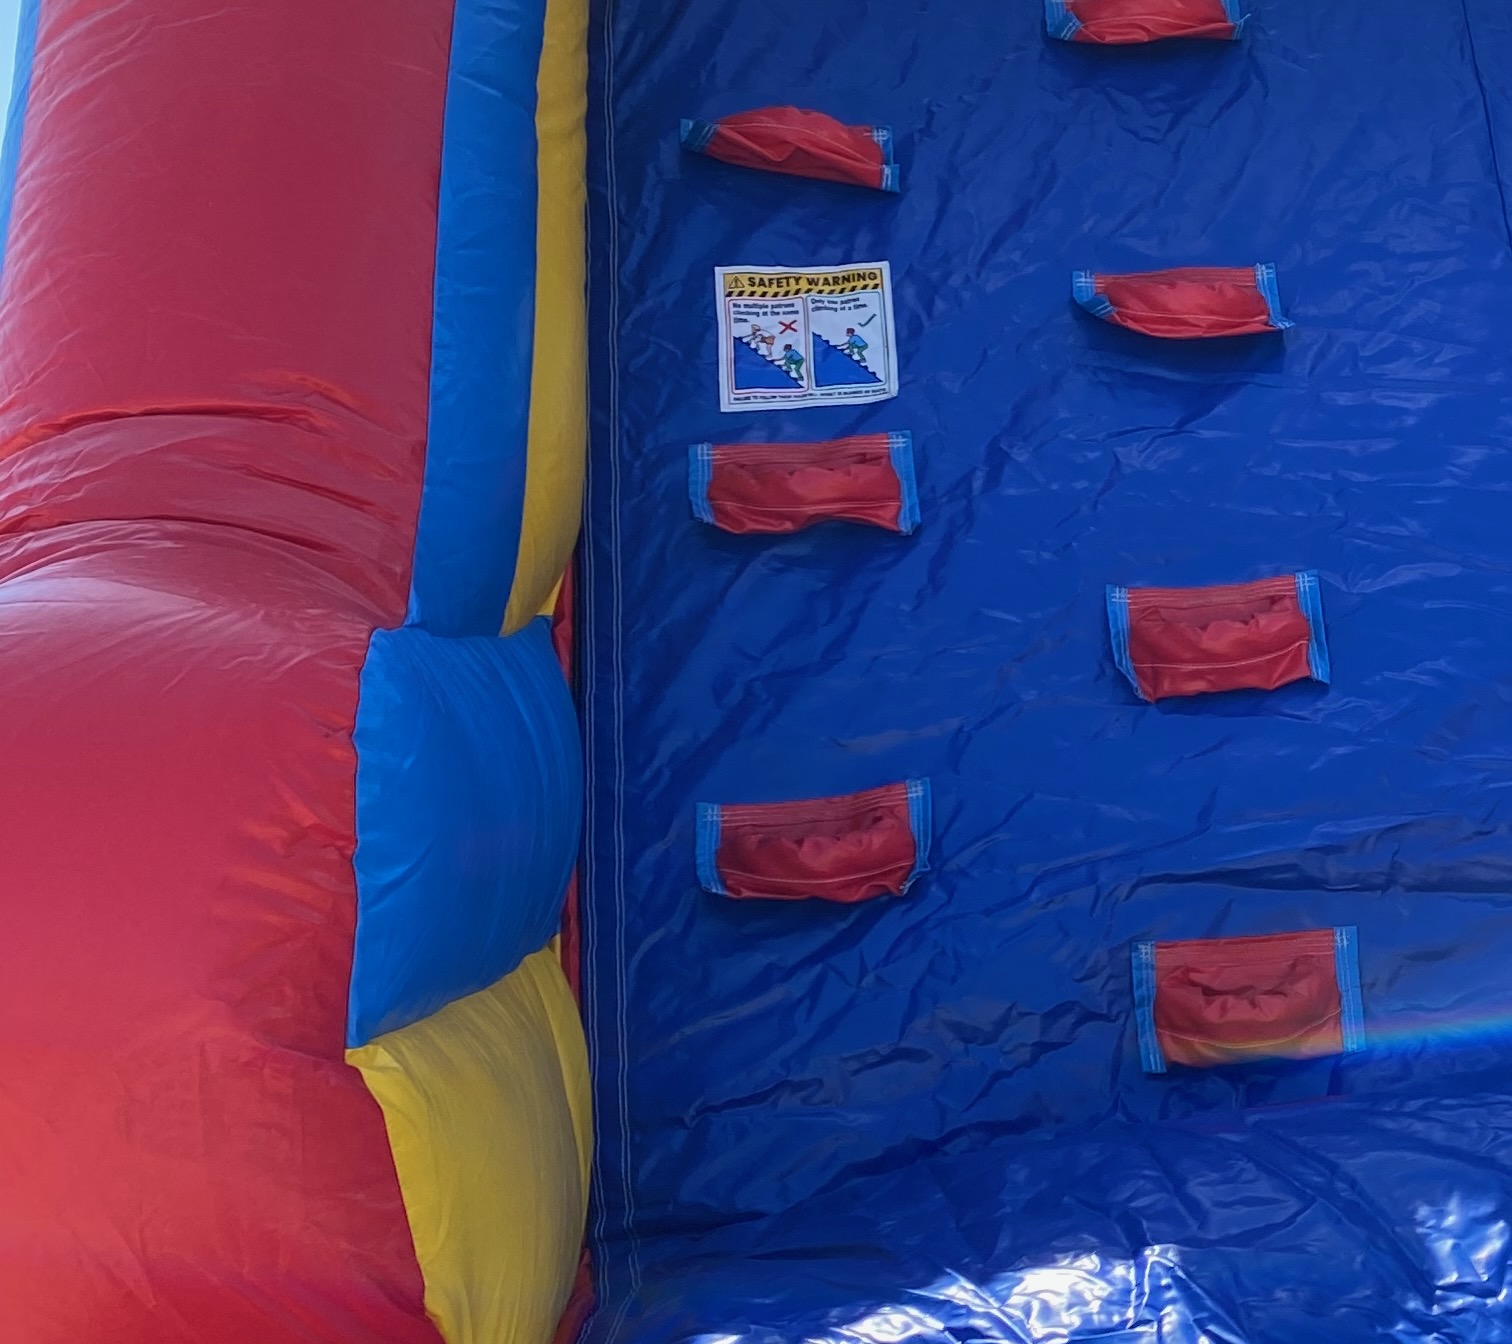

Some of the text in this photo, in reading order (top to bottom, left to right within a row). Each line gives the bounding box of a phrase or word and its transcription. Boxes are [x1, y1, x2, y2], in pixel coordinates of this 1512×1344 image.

[747, 271, 878, 289] SAFETY WARNING
[811, 305, 838, 313] climbing
[733, 310, 760, 318] climbing
